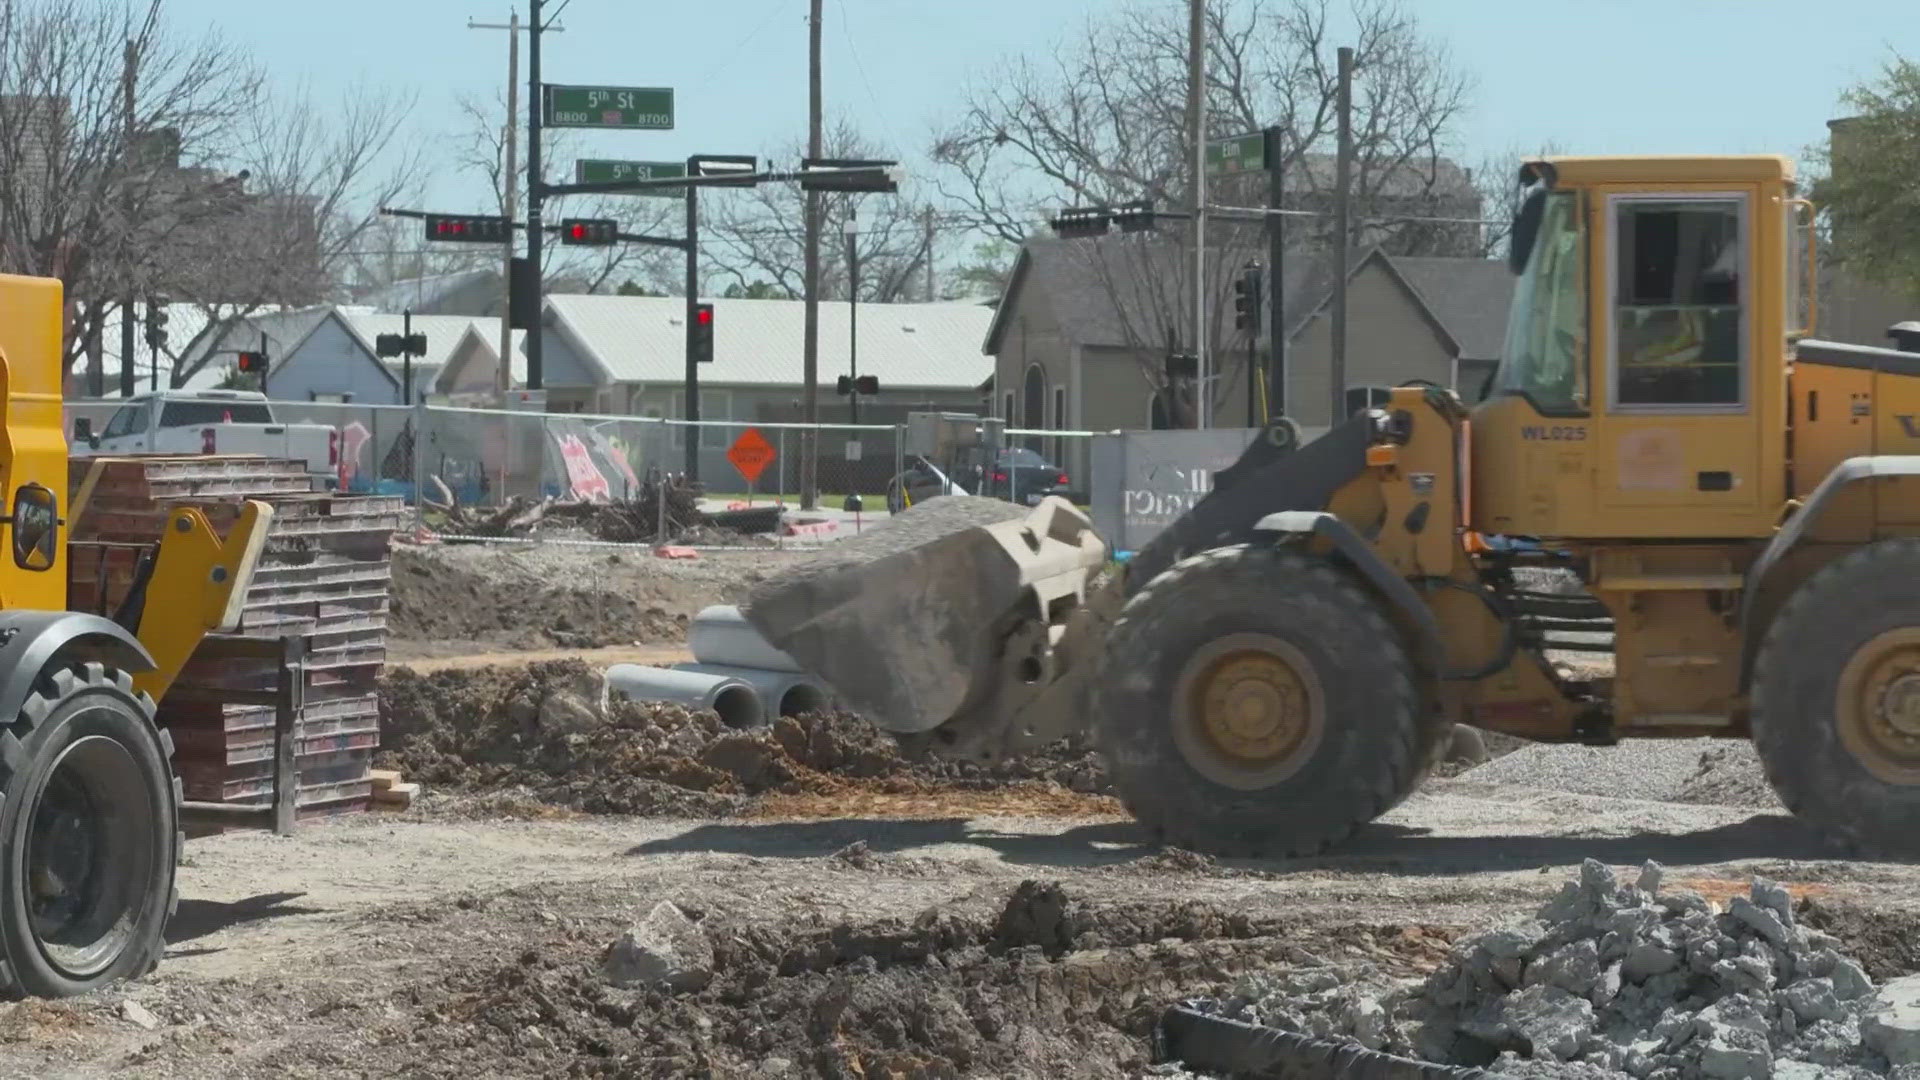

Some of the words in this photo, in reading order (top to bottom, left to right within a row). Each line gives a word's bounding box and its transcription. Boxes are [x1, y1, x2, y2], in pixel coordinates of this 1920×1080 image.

[588, 91, 610, 109] 5th
[617, 92, 635, 109] St
[555, 111, 588, 123] 8800
[638, 113, 669, 125] 8700
[1222, 141, 1240, 158] Elm
[613, 164, 632, 179] 5th
[638, 166, 653, 181] St
[1521, 426, 1585, 440] WL025
